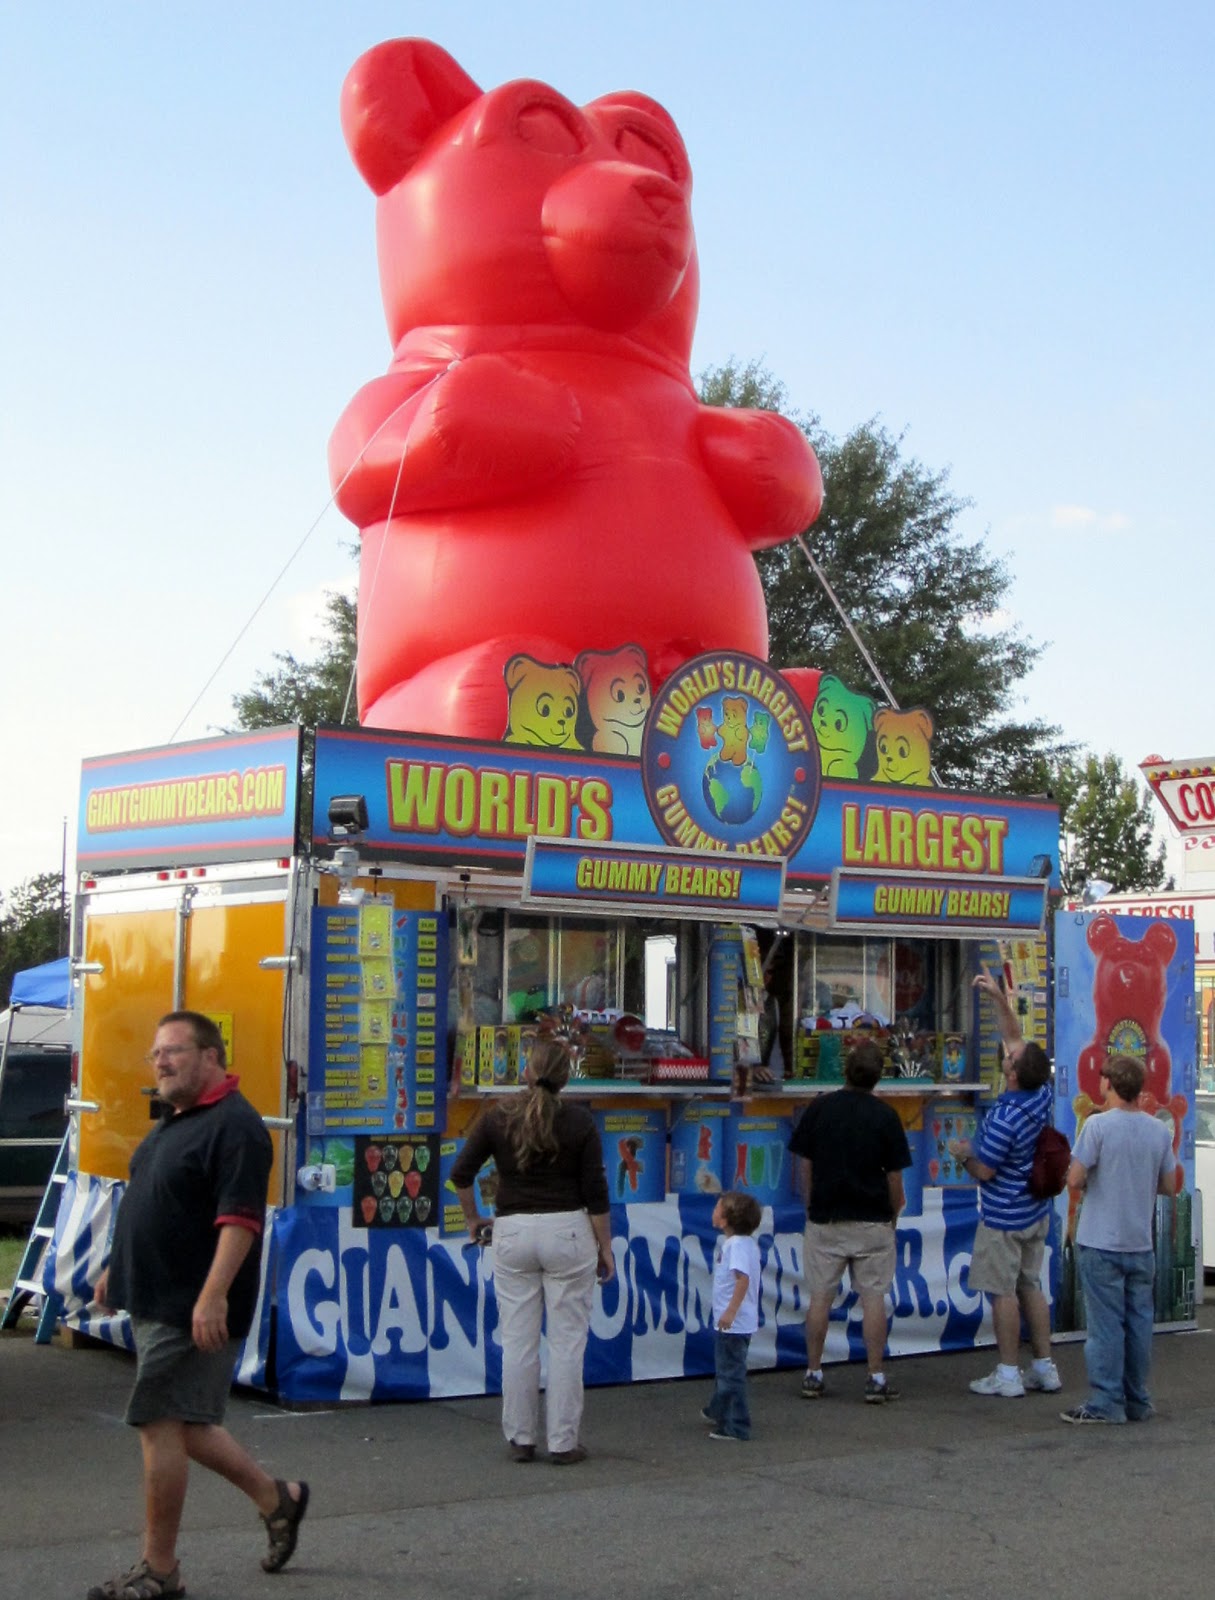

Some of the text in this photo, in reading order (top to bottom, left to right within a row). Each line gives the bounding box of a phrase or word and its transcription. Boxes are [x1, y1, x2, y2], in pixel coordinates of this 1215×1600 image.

[656, 661, 810, 753] WORLD'S LARGEST
[86, 765, 286, 830] GIANTGUMMYBEARS.COM
[387, 760, 611, 840] WORLD'S
[1178, 782, 1215, 822] CO
[843, 803, 1008, 874] LARGEST
[576, 857, 741, 900] GUMMY BEARS!
[874, 885, 1011, 919] GUMMY BEARS!
